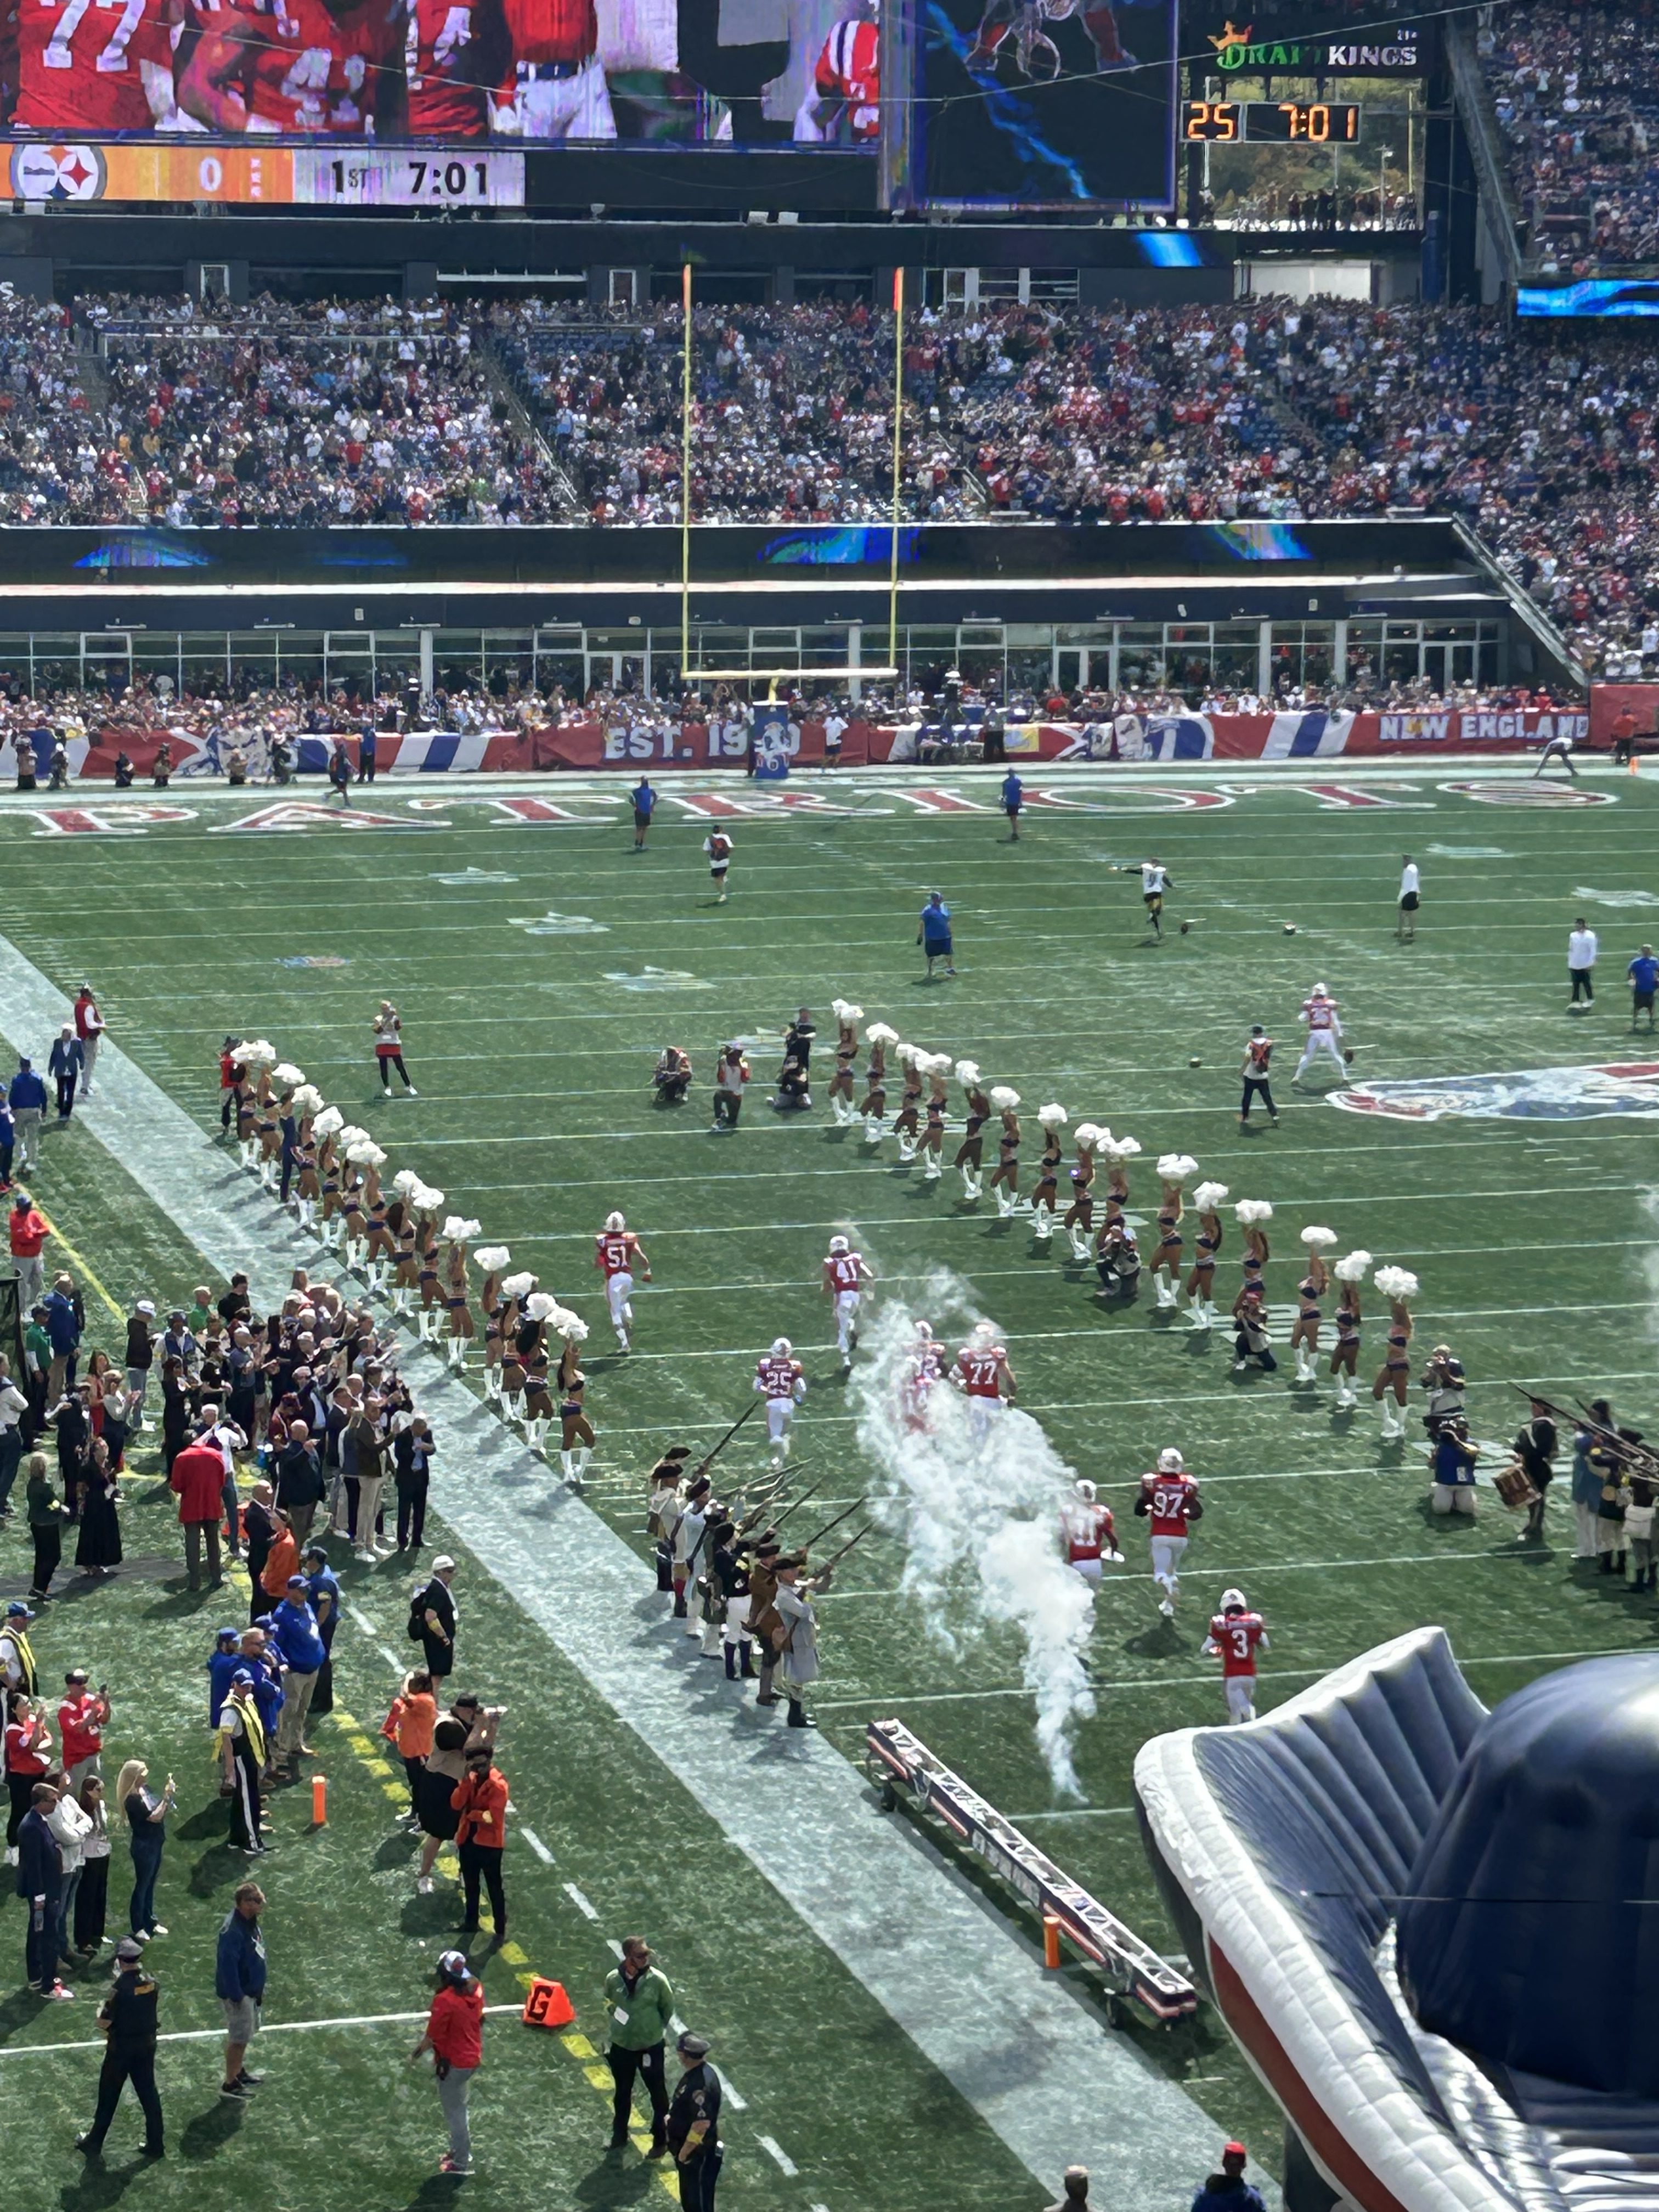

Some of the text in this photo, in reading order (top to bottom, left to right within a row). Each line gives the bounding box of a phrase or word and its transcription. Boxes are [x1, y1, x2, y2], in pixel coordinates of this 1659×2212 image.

[1328, 46, 1417, 66] KINGS
[1188, 103, 1234, 139] 25
[1279, 103, 1355, 142] 7:01
[199, 156, 223, 193] 0
[409, 162, 487, 195] 7:01
[605, 726, 692, 759] EST.
[1379, 715, 1589, 740] NEW ENGLAND
[0, 780, 1617, 837] PATRIOTS
[607, 1245, 627, 1268] 51
[766, 1372, 792, 1395] 25
[970, 1361, 997, 1385] 77
[1153, 1492, 1184, 1518] 97
[1231, 1629, 1248, 1657] 3
[528, 1985, 553, 2021] G
